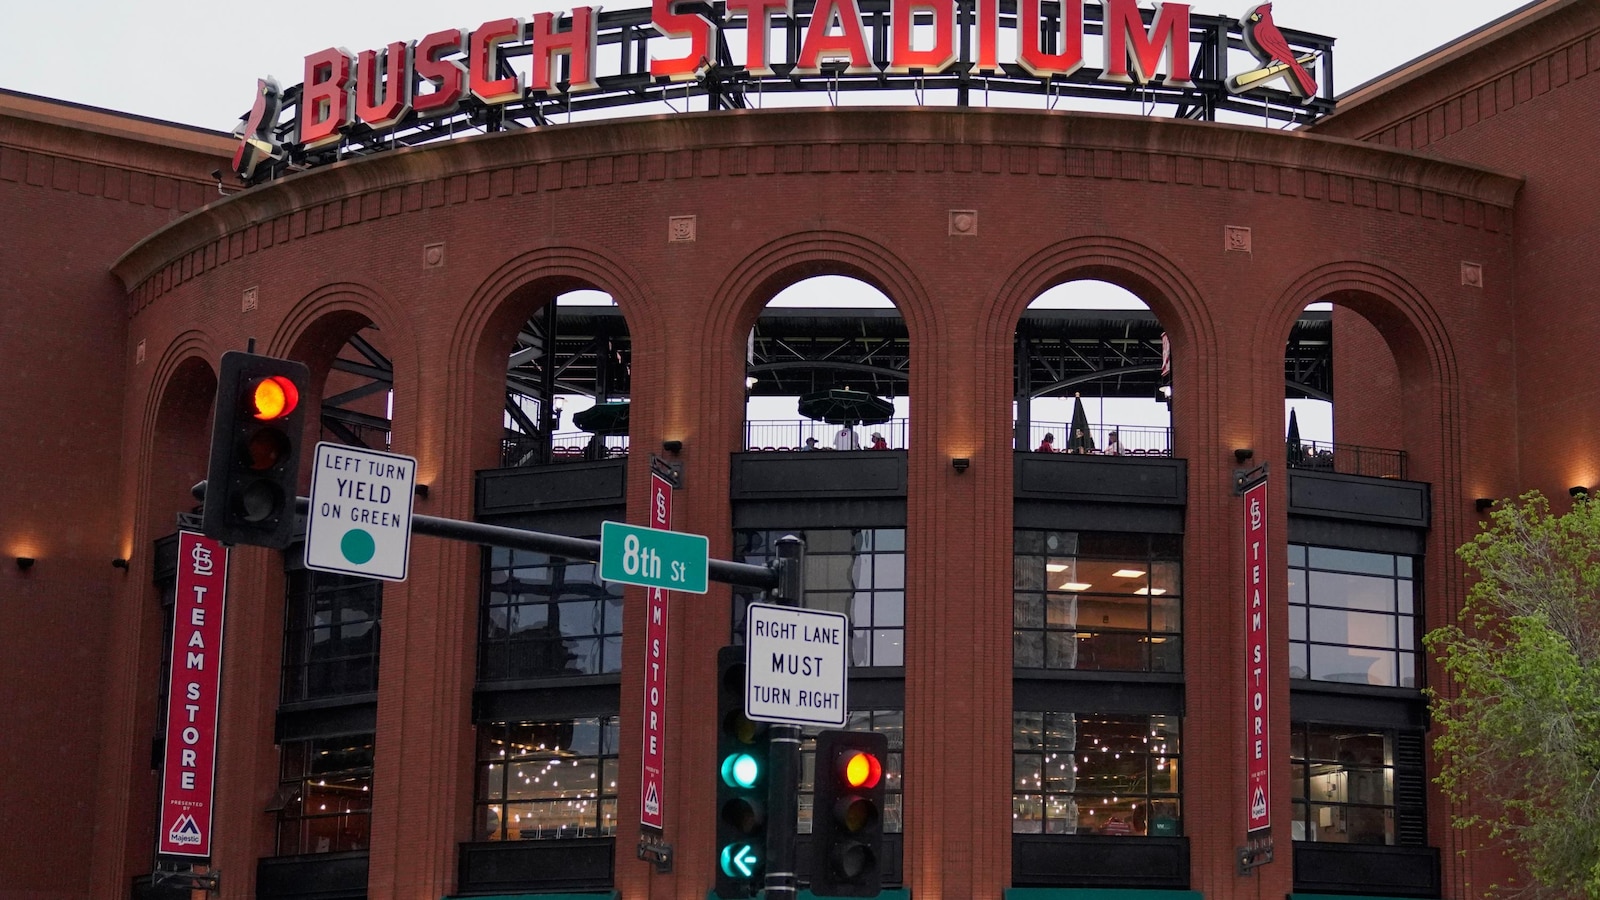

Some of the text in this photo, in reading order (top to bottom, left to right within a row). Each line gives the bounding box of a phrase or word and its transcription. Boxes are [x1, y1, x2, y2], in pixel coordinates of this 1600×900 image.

[300, 0, 1195, 147] BUSCH STADIUM
[326, 454, 405, 480] LEFT TURN
[337, 478, 391, 504] YIELD
[321, 503, 401, 528] ON GREEN
[623, 534, 686, 582] 8th St
[756, 620, 839, 645] RIGHT LANE
[1253, 541, 1262, 760] TEAM STORE
[650, 588, 661, 755] AM STORE
[772, 652, 823, 677] MUST
[181, 586, 207, 790] TEAM STORE
[754, 686, 840, 709] TURN RIGHT
[170, 799, 204, 808] PRESENTED
[171, 834, 199, 843] Majestic
